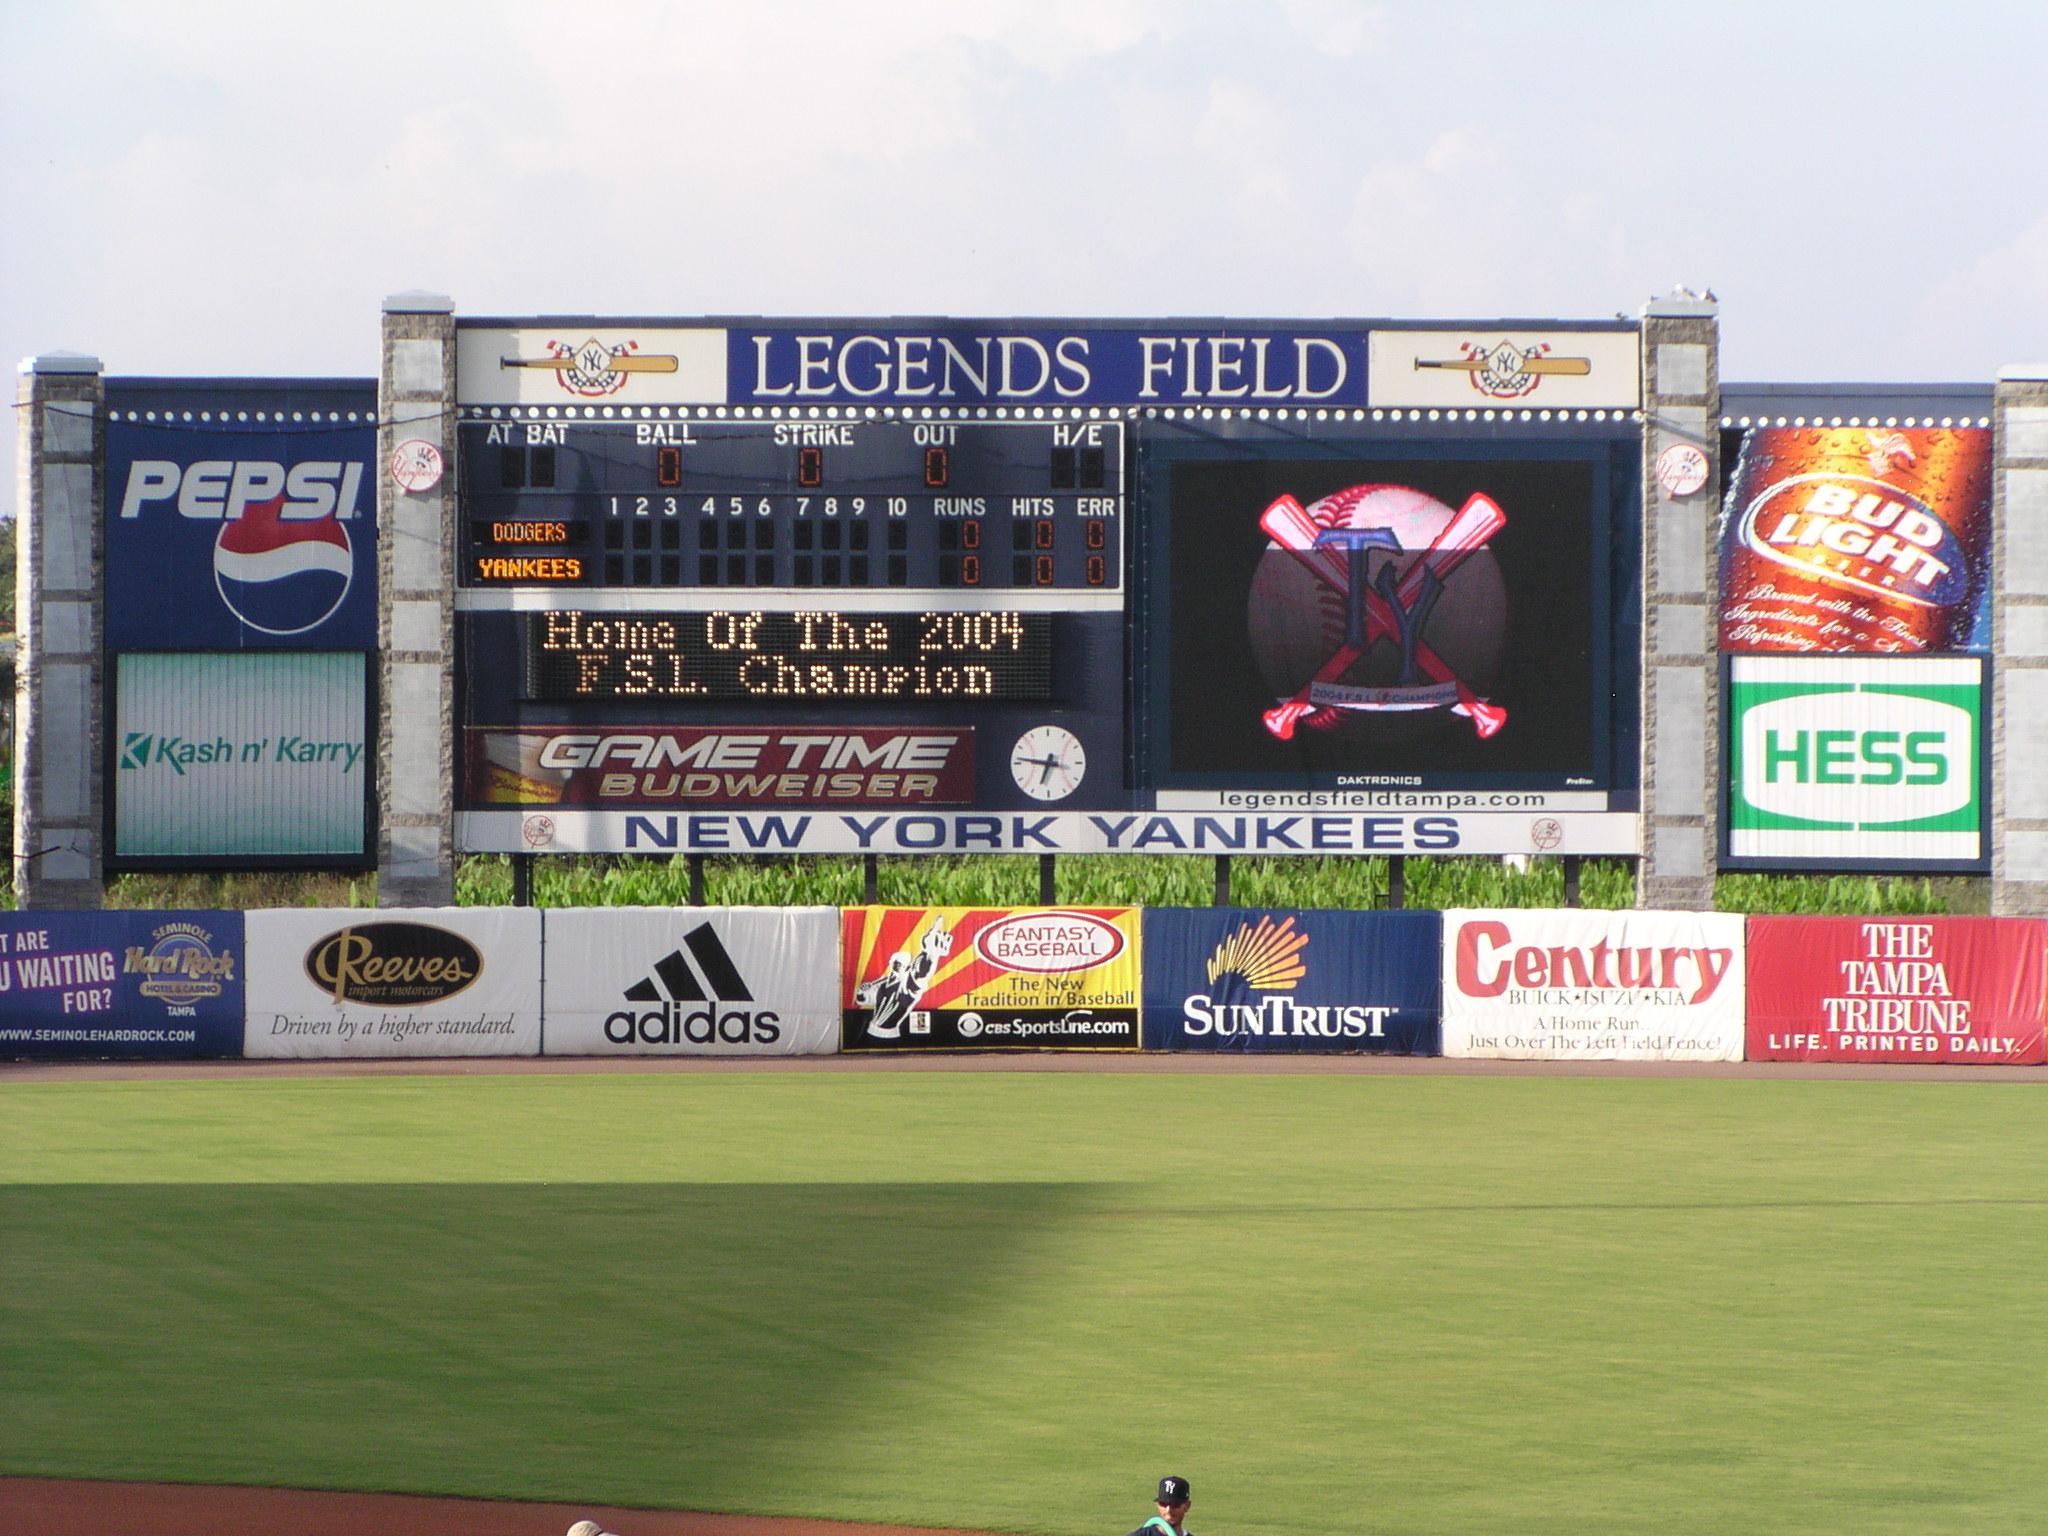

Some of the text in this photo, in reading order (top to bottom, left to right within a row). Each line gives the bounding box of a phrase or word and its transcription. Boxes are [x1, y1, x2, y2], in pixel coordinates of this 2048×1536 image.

[751, 335, 1348, 399] LEGENDS FIELD
[486, 423, 569, 445] AT BAT
[636, 424, 697, 445] BALL
[774, 424, 854, 446] STRIKE
[913, 424, 959, 446] OUT
[1053, 424, 1103, 446] H/E
[658, 447, 682, 486] 0
[799, 447, 822, 486] 0
[925, 447, 948, 486] 0
[120, 460, 364, 520] PEPSI
[611, 497, 1115, 516] 1 2 3 4 5 6 7 8 9 10 RUNS HITS ERR
[1803, 484, 1944, 547] BUD
[493, 522, 568, 543] DODGERS
[963, 520, 1105, 548] 0 0 0
[1768, 512, 1951, 587] LIGHT
[479, 557, 581, 579] YANKEES
[963, 555, 1105, 584] 0 0 0
[1724, 603, 1821, 628] Ingredients
[1818, 618, 1851, 636] for
[1744, 583, 1818, 604] Brewed
[1816, 598, 1852, 616] with
[1852, 606, 1878, 624] the
[1877, 615, 1929, 649] Finest
[543, 611, 1024, 650] Home Of The 2004
[1728, 624, 1818, 651] Refreshing
[576, 654, 992, 693] F.S.L. Champion
[155, 736, 233, 776] Kash
[275, 736, 364, 775] Karry
[538, 735, 960, 770] GAME TIME
[1764, 729, 1948, 786] HESS
[599, 773, 939, 798] BUDWEISER
[1337, 775, 1423, 786] DAKTRONICS
[1220, 791, 1546, 810] legendsfieldtampa.com
[624, 815, 1461, 850] NEW YORK YANKEES
[16, 930, 50, 953] ARE
[152, 922, 213, 944] SEMINOLE
[1001, 926, 1097, 942] FANTASY
[1862, 923, 1934, 958] THE
[123, 946, 235, 981] Hard Rock
[999, 943, 1102, 957] BASEBALL
[1455, 920, 1734, 1006] Century
[16, 951, 116, 990] WAITING
[315, 928, 473, 1005] Reeves
[1841, 961, 1952, 996] TAMPA
[348, 984, 444, 999] import motorcars
[1009, 977, 1085, 991] The New
[1509, 989, 1571, 1006] BUICK
[1653, 989, 1688, 1006] KIA
[63, 988, 112, 1013] FOR?
[167, 1006, 196, 1017] TAMPA
[964, 991, 1135, 1006] Tradition in Baseball
[271, 1012, 516, 1042] Driven by a higher standard.
[603, 1001, 781, 1046] adidas
[1012, 1015, 1130, 1037] SportsLine.com
[1533, 1017, 1546, 1031] A
[1552, 1016, 1601, 1031] Home
[1823, 998, 1973, 1035] TRIBUNE
[1467, 1034, 1499, 1050] Just
[1504, 1036, 1546, 1050] Over
[1549, 1035, 1581, 1050] The
[1769, 1033, 2021, 1054] LIFE. PRINTED DAILY.
